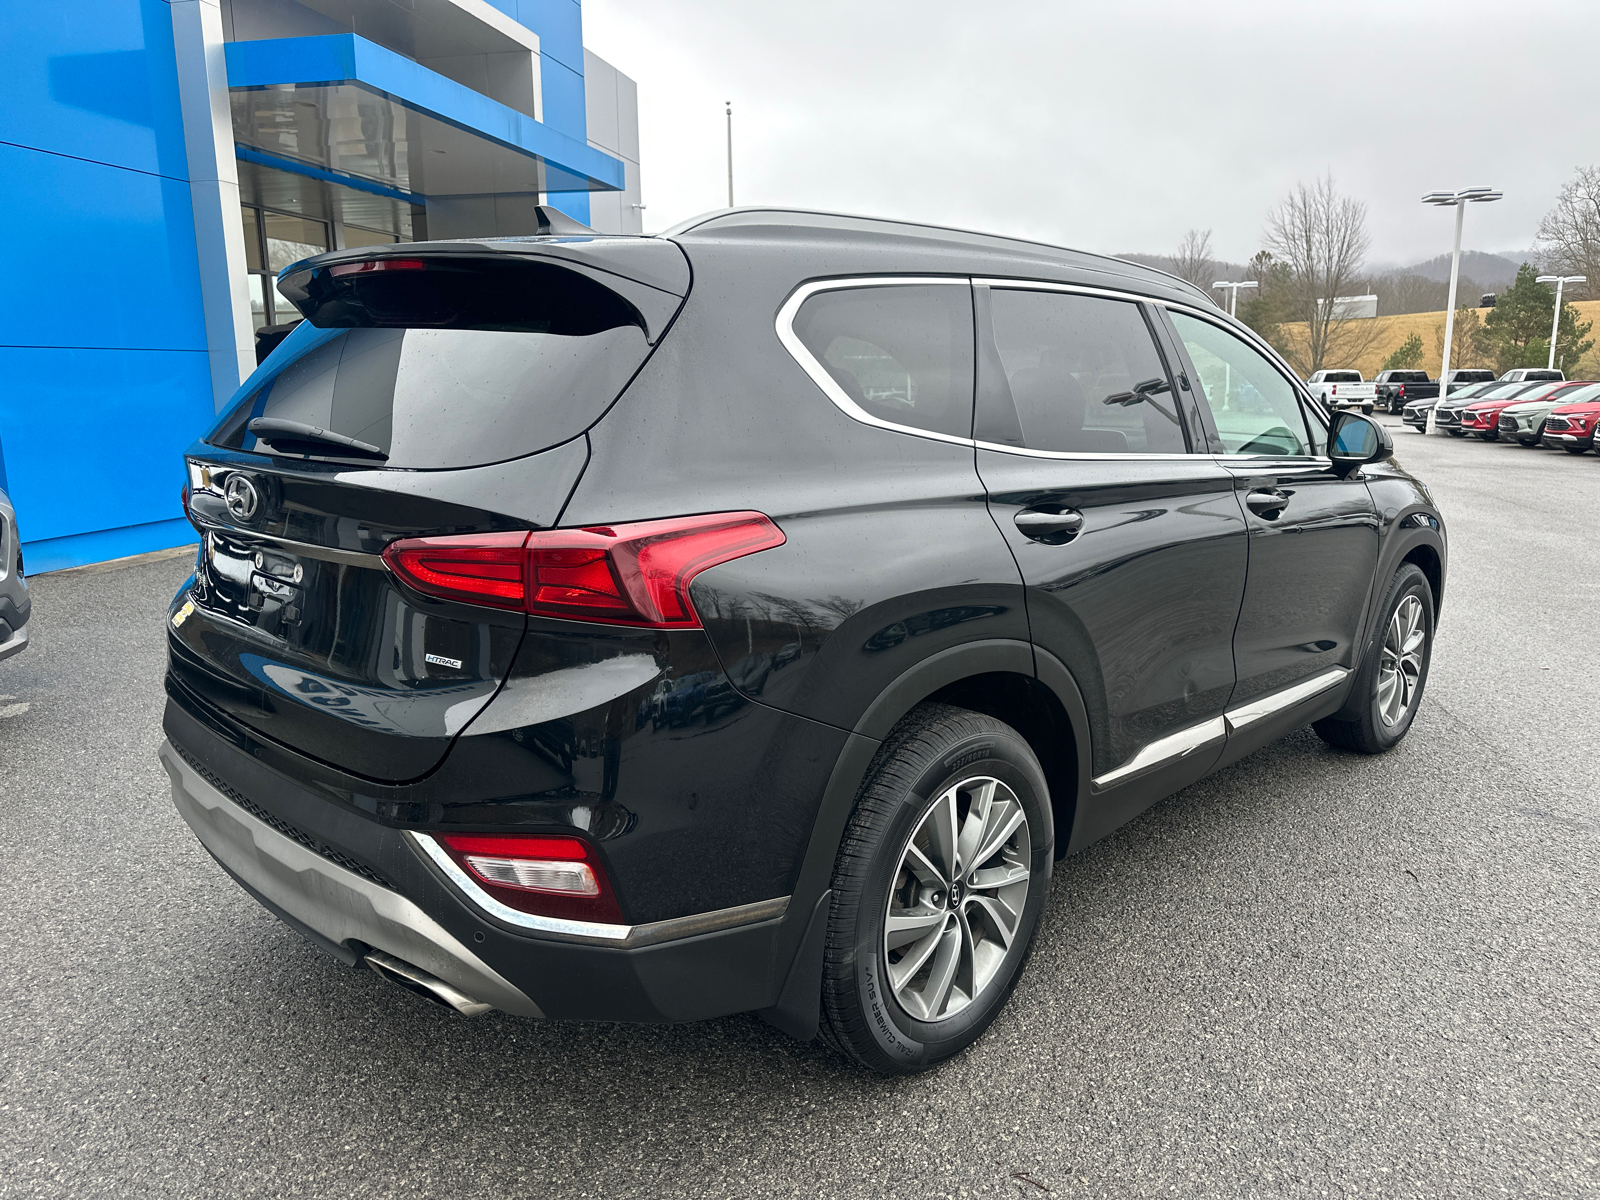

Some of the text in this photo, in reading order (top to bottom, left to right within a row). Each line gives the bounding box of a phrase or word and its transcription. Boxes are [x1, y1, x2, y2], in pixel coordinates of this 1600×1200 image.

[427, 655, 459, 667] HTRAC
[866, 972, 917, 1057] TRAIL CLIMBER SUV
